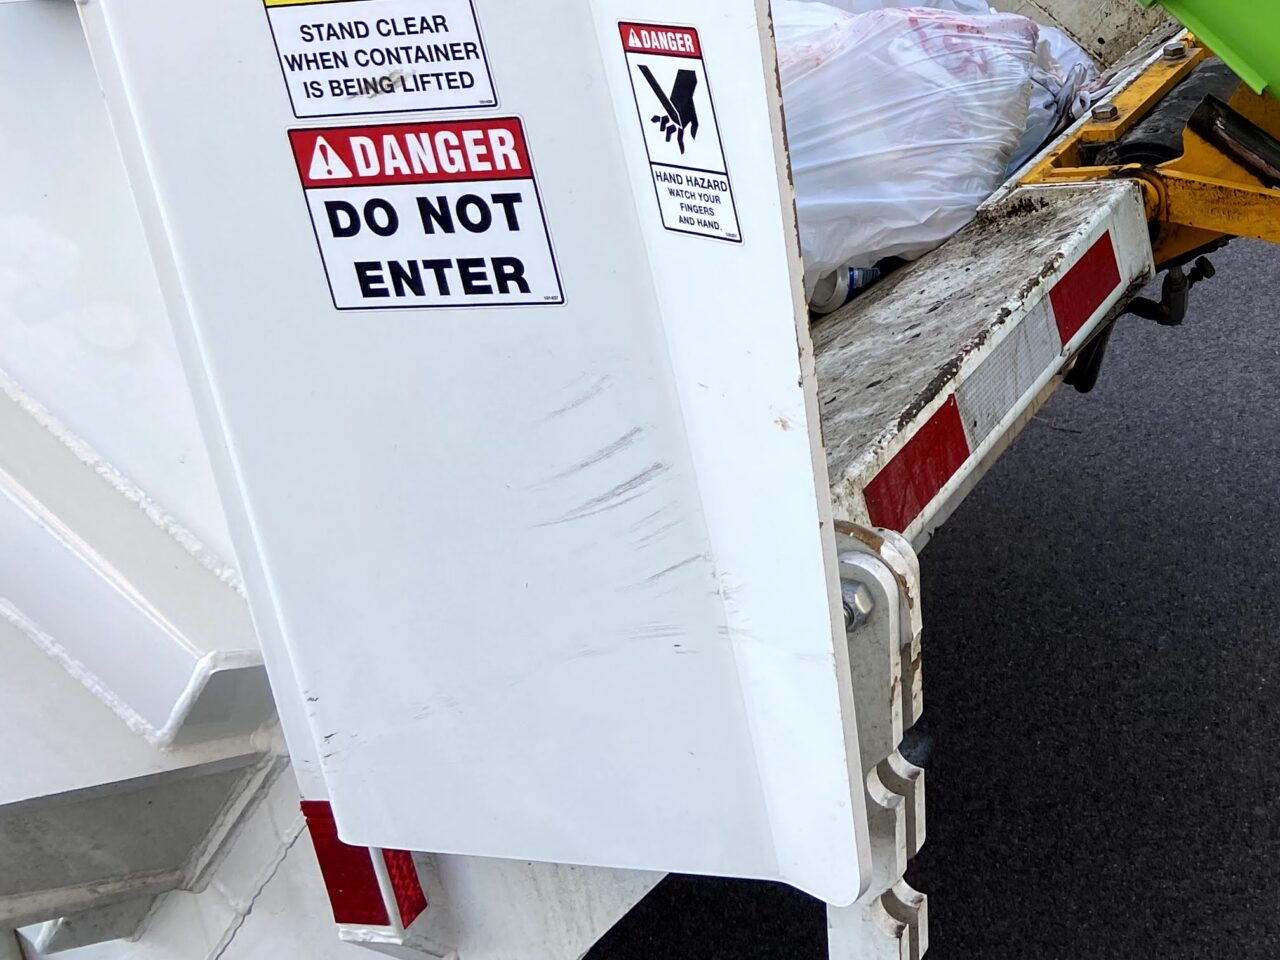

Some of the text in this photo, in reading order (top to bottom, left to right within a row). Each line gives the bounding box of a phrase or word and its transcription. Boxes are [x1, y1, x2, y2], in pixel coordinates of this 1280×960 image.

[299, 15, 449, 42] STAND CLEAR
[640, 30, 695, 53] DANGER
[284, 42, 480, 72] WHEN CONTAINER
[303, 71, 475, 99] IS BEING LIFTED
[348, 128, 522, 177] DANGER
[655, 170, 728, 192] HAND HAZARD
[667, 187, 721, 205] WATCH YOUR
[679, 202, 715, 216] FINGERS
[324, 193, 523, 238] DO NOT
[679, 215, 695, 227] AND
[354, 257, 531, 298] ENTER
